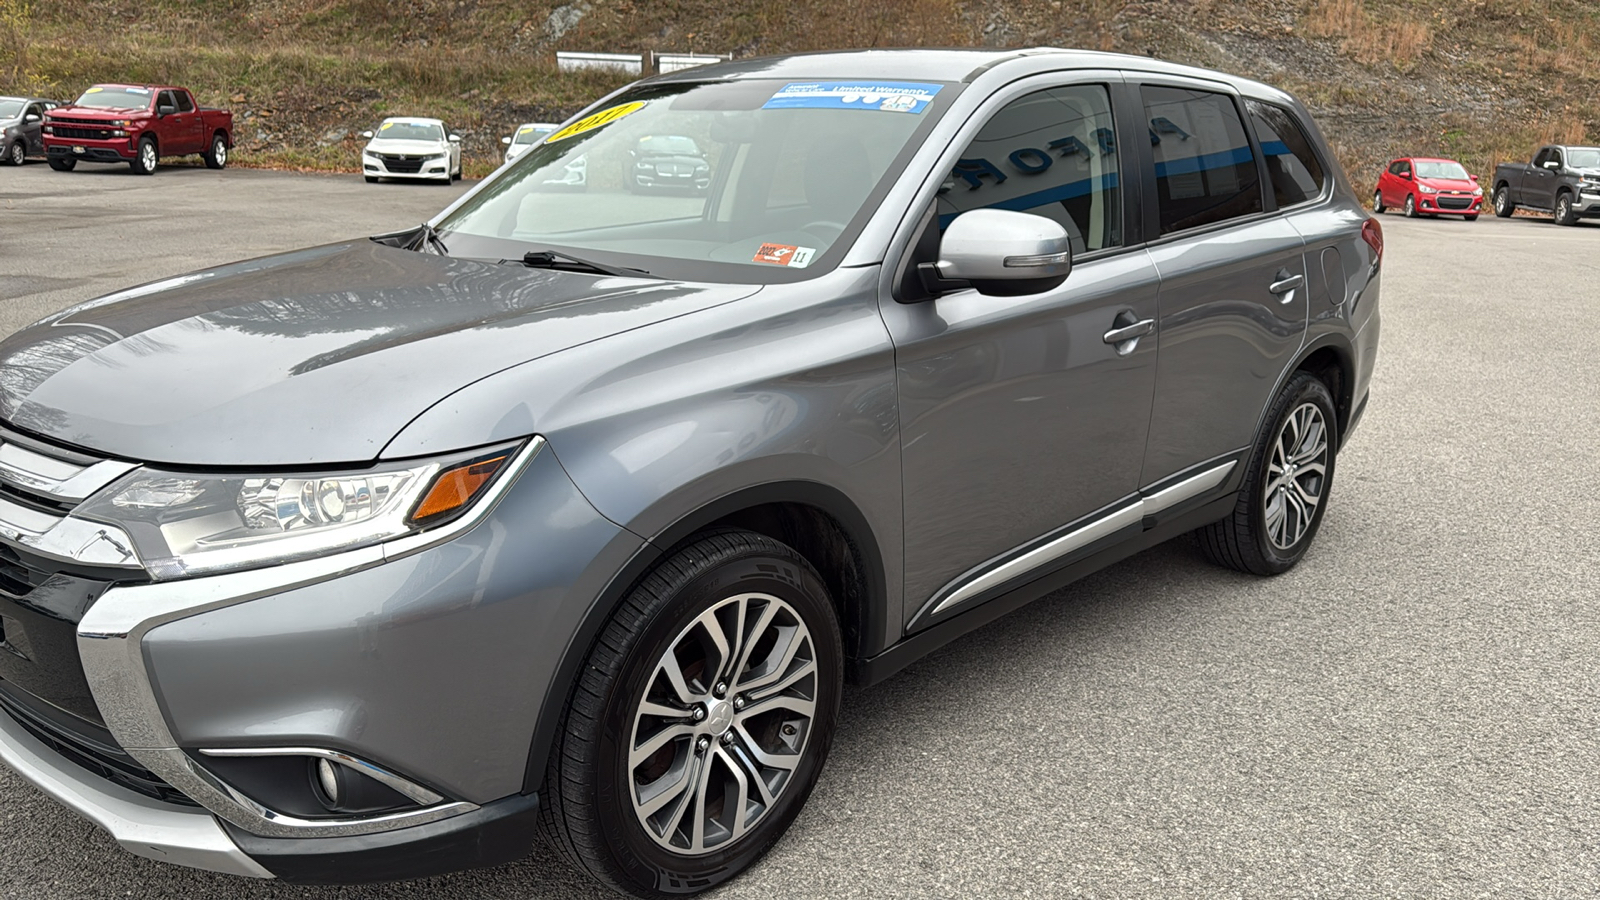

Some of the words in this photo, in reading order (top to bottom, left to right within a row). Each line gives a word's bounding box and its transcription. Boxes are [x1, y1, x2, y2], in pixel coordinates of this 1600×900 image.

[876, 86, 929, 95] Warranty
[553, 104, 633, 138] 2017
[793, 251, 807, 263] 11
